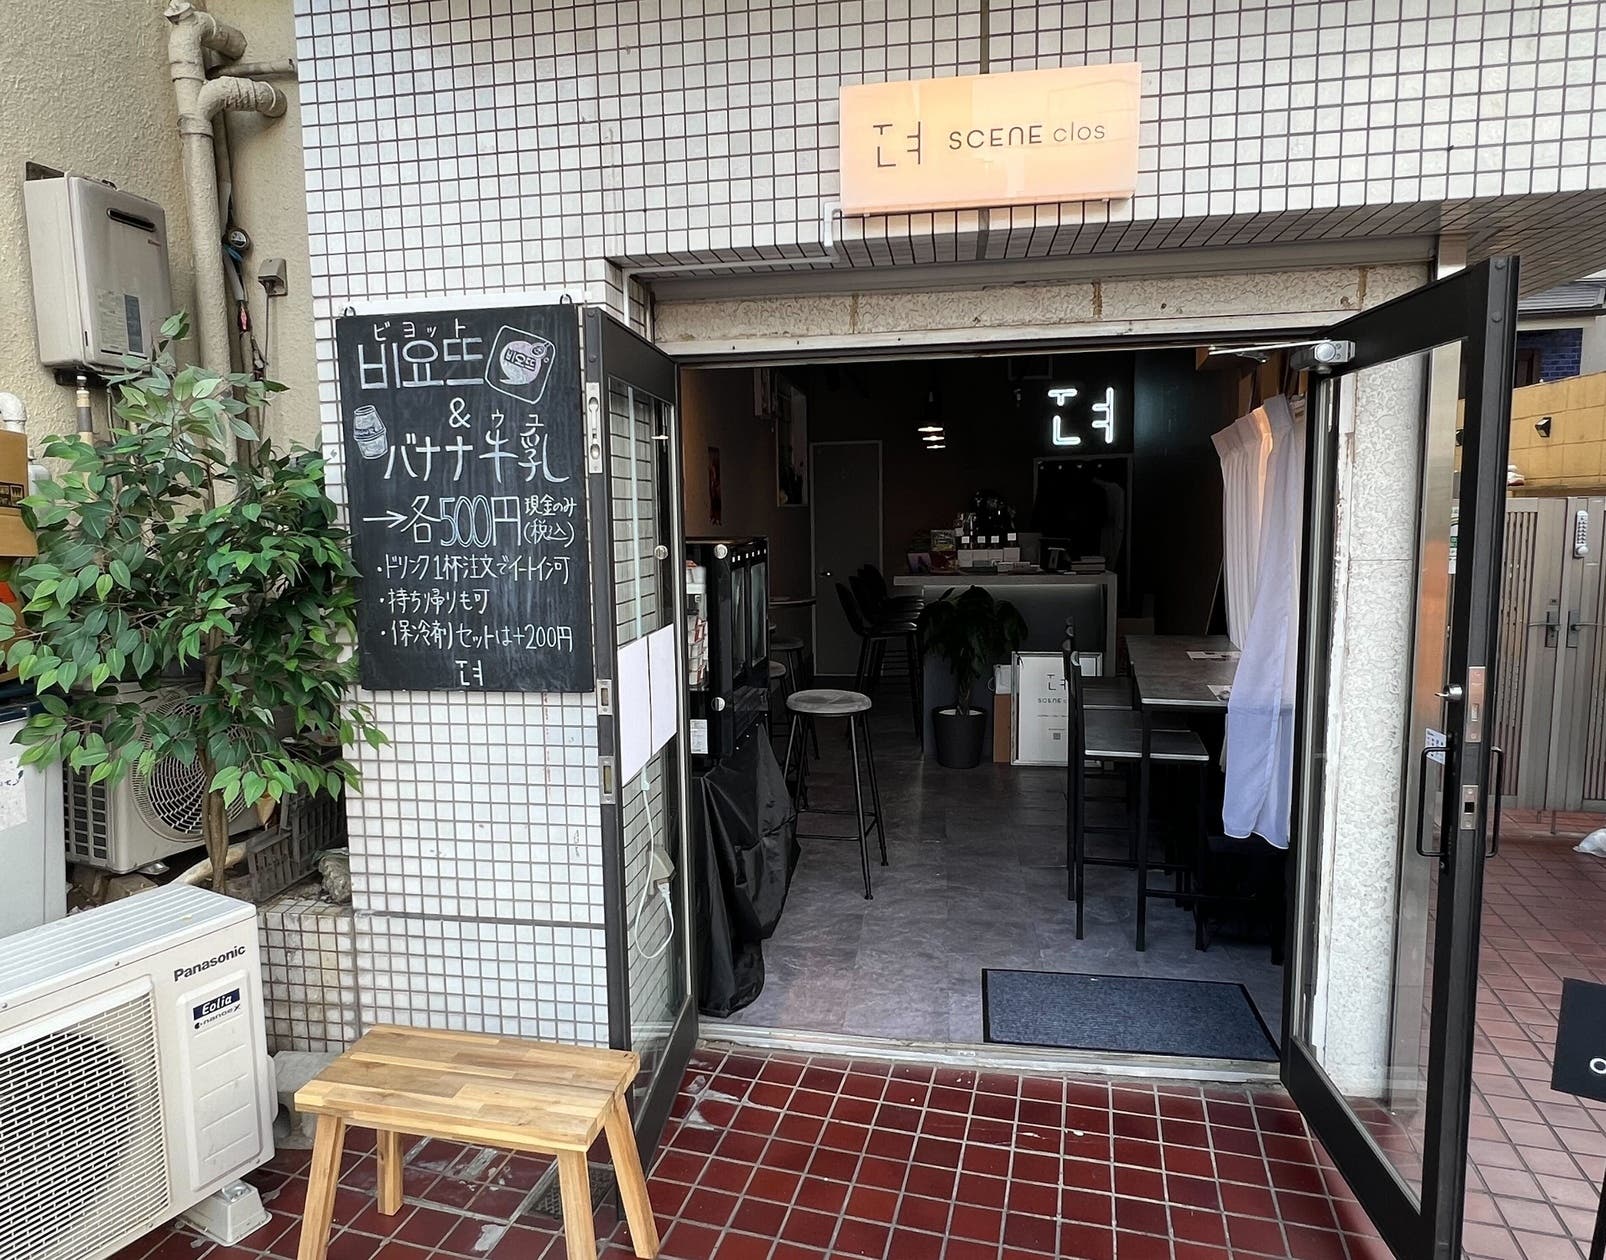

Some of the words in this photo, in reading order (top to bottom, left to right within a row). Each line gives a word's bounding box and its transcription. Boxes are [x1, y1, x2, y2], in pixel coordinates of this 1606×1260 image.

[949, 125, 1042, 150] SCENE
[1053, 121, 1105, 143] clos
[358, 337, 485, 390] 비요뜨
[449, 397, 471, 428] &
[383, 427, 570, 484] バナナ牛乳
[400, 495, 522, 548] 各500円
[525, 494, 577, 517] 現金のみ
[173, 945, 246, 982] Panasonic
[201, 995, 232, 1016] Eolia
